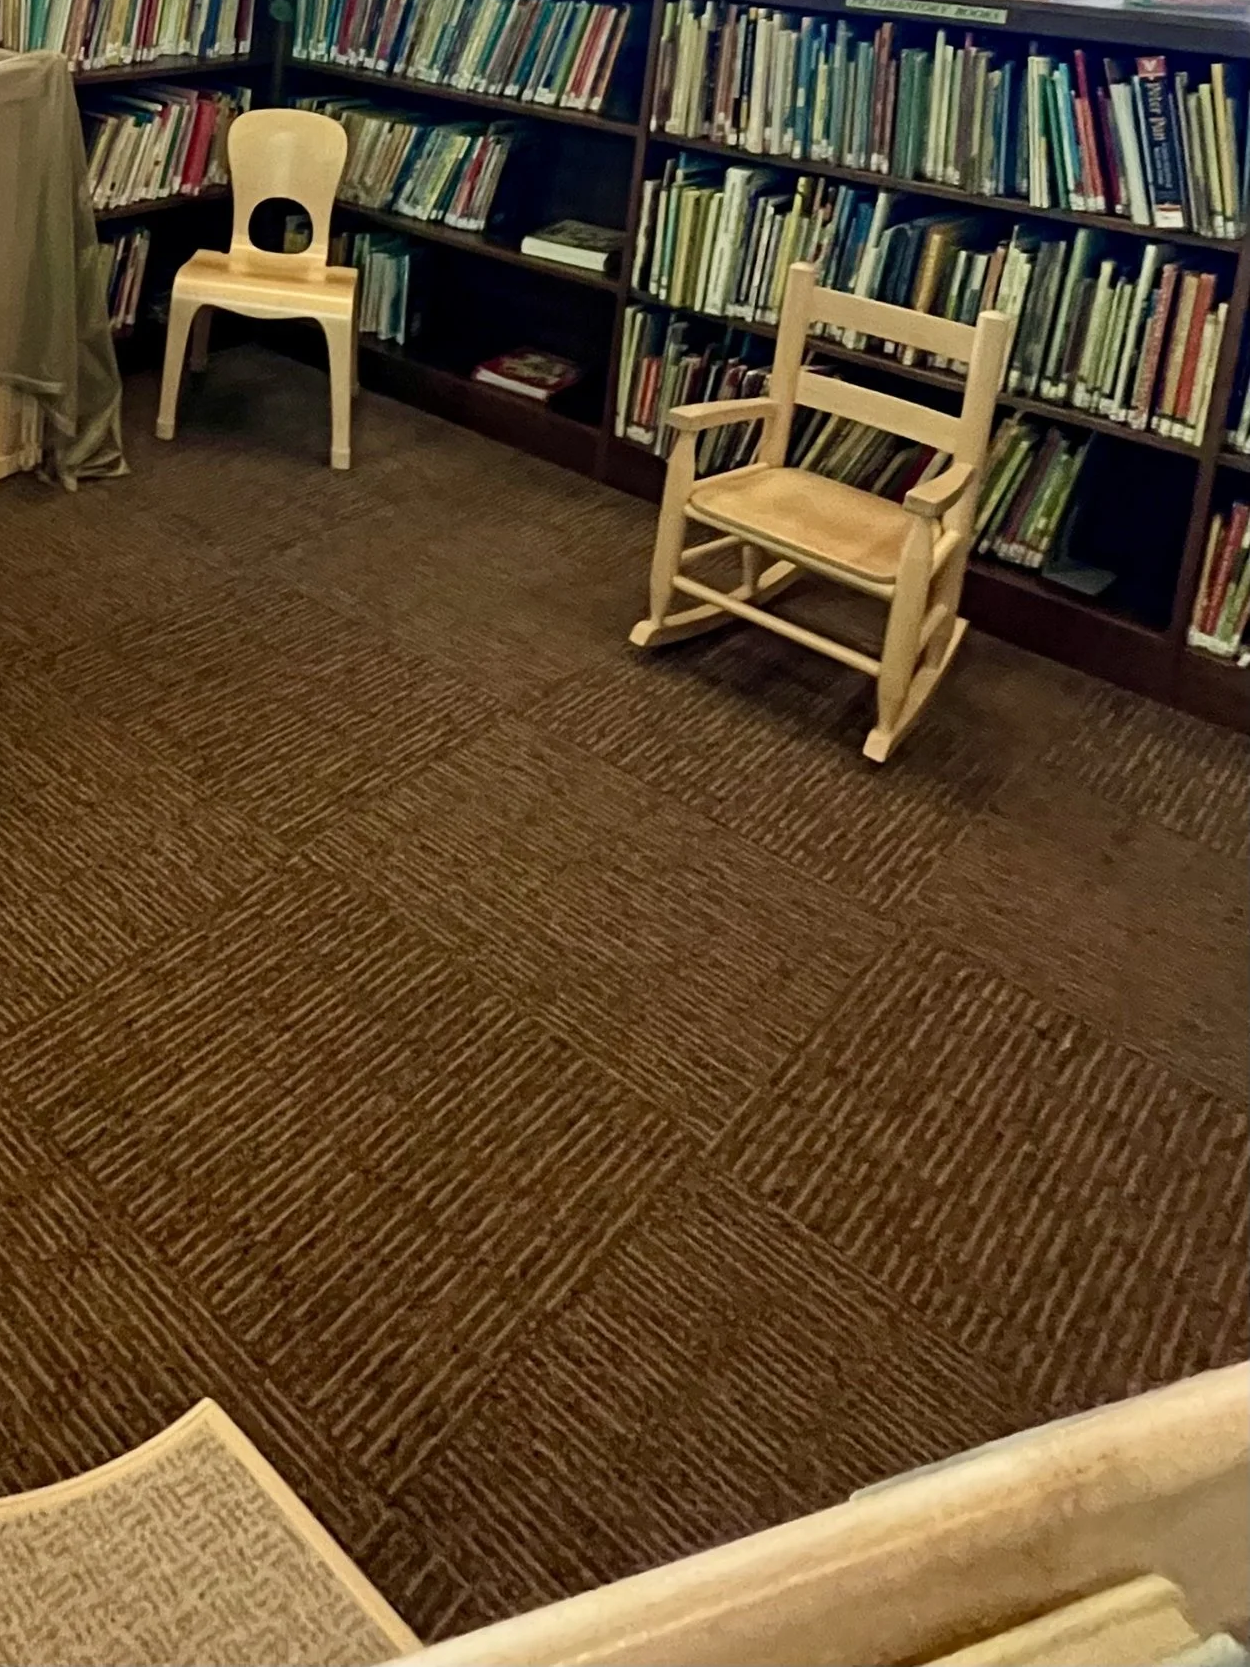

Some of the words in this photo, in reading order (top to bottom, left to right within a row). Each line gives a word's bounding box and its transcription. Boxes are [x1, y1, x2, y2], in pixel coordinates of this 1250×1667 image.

[955, 6, 1000, 21] BOOKS
[1145, 82, 1163, 114] Peter
[1148, 116, 1167, 141] Pan
